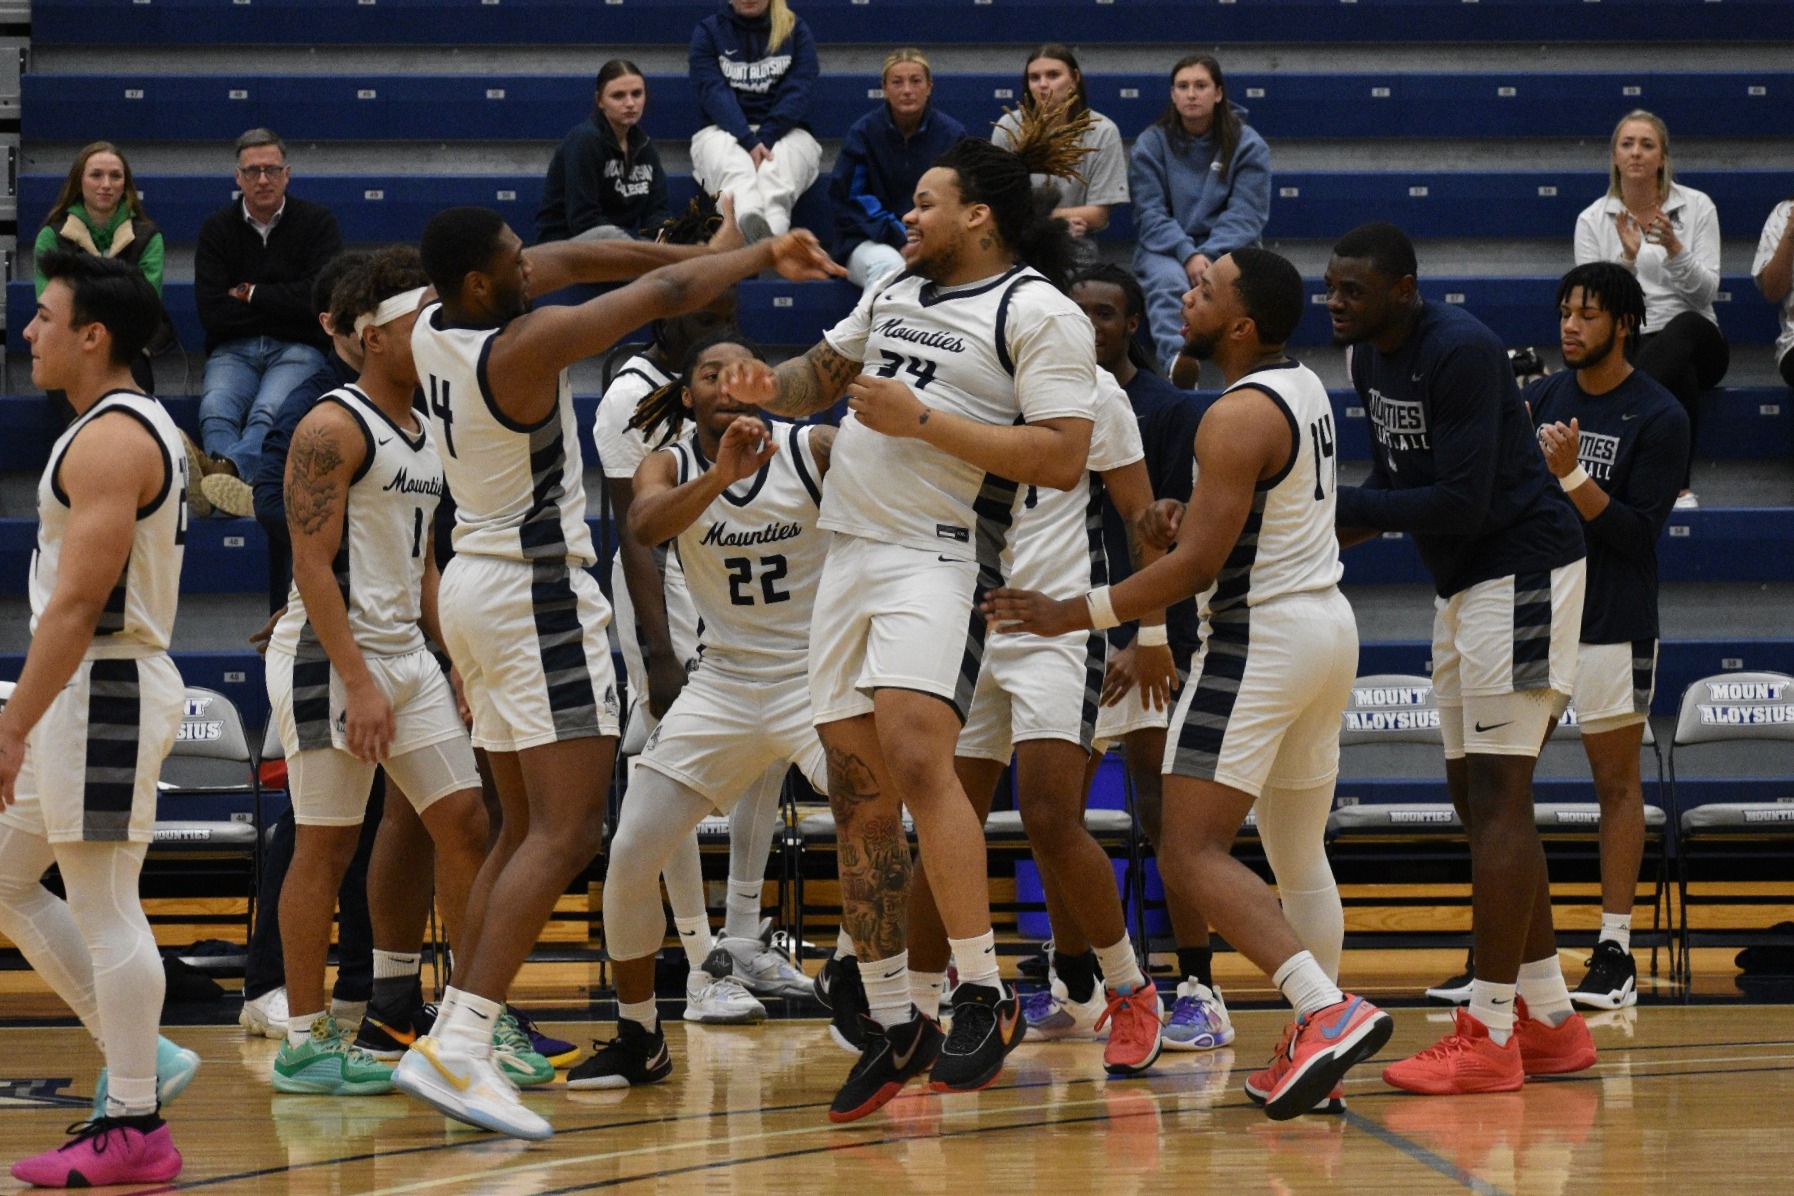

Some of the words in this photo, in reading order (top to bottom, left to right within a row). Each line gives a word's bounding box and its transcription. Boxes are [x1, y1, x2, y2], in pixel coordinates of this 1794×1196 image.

[874, 318, 966, 353] Mounties
[875, 348, 938, 390] 34
[428, 373, 458, 459] 4
[1310, 414, 1334, 501] 14
[411, 506, 423, 558] 1
[699, 521, 802, 547] Mounties
[724, 553, 790, 606] 22
[1357, 689, 1427, 705] MOUNT
[1712, 684, 1782, 699] MOUNT
[1348, 711, 1440, 729] ALOYSIUS
[1702, 705, 1794, 723] ALOYSIUS
[1390, 812, 1452, 822] MOUNTIES
[1557, 812, 1600, 822] MOUNT
